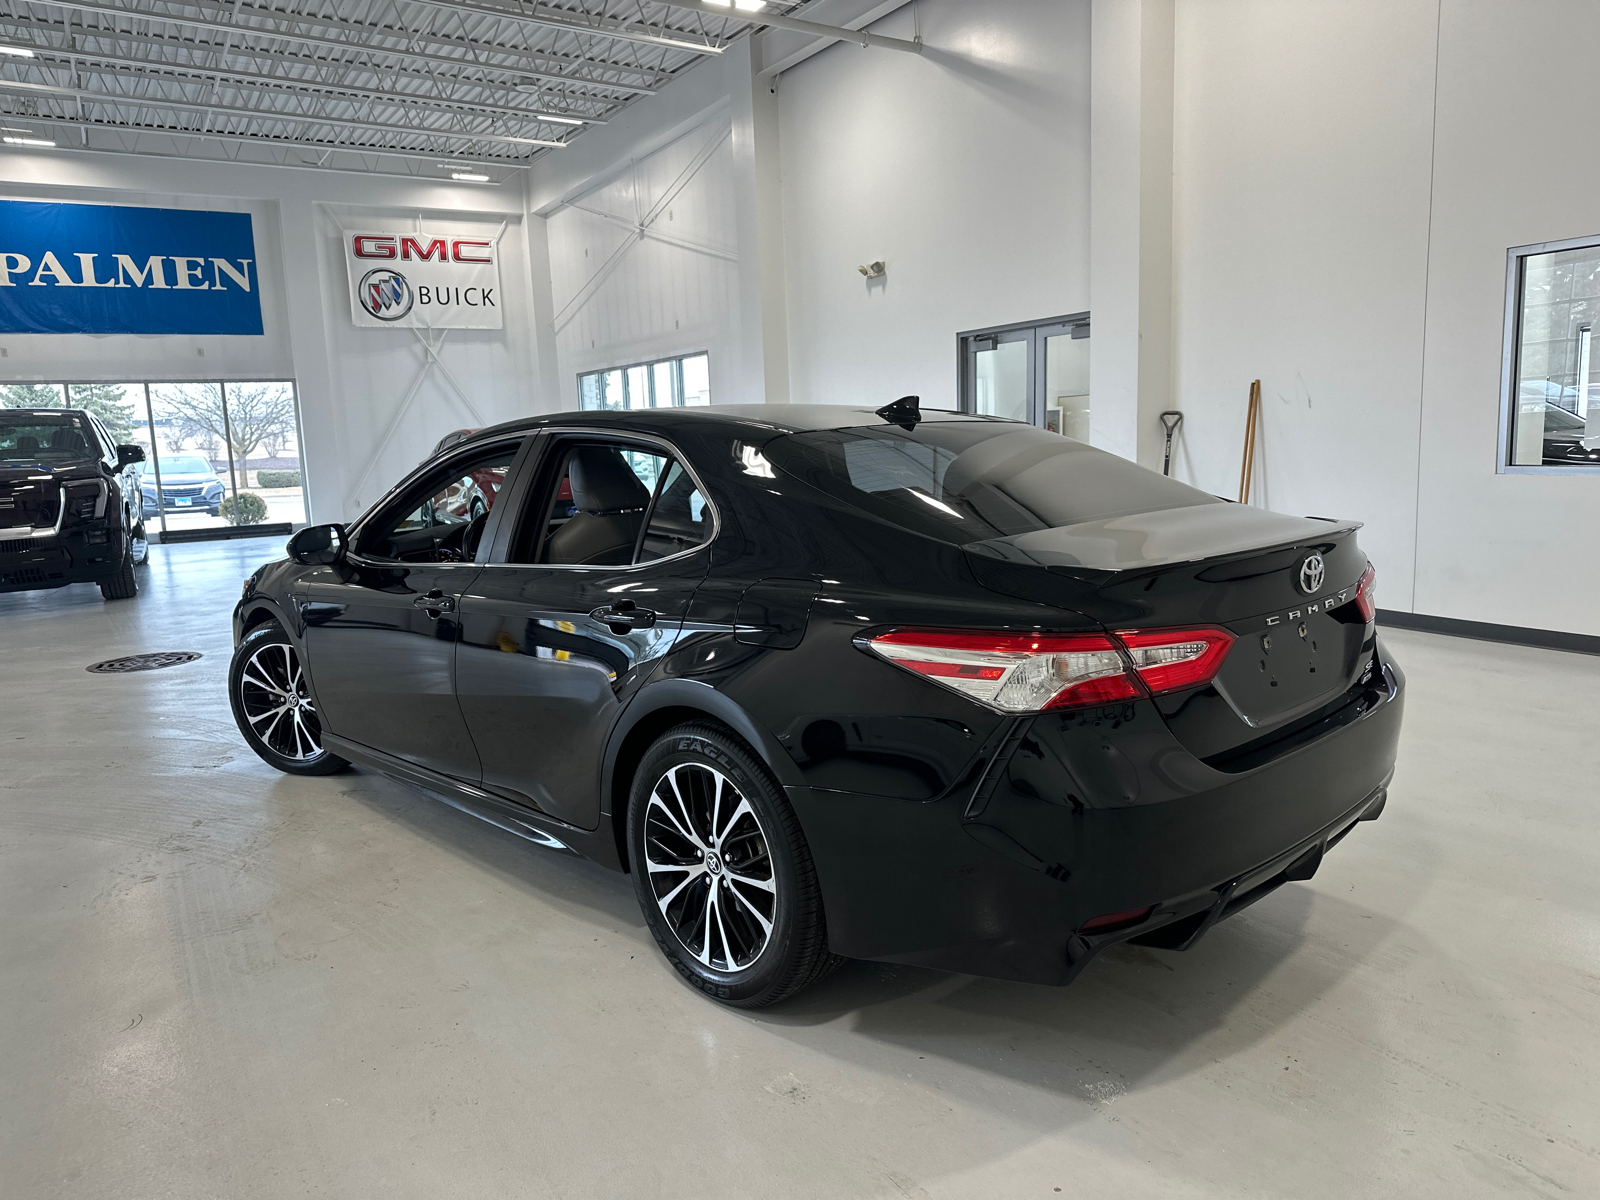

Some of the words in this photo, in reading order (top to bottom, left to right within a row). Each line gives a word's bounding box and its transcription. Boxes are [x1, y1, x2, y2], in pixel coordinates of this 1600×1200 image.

[352, 233, 493, 265] GMC
[0, 250, 252, 293] PALMEN
[418, 286, 495, 307] BUICK
[1265, 593, 1347, 626] CAMRY
[678, 740, 747, 782] EAGLE
